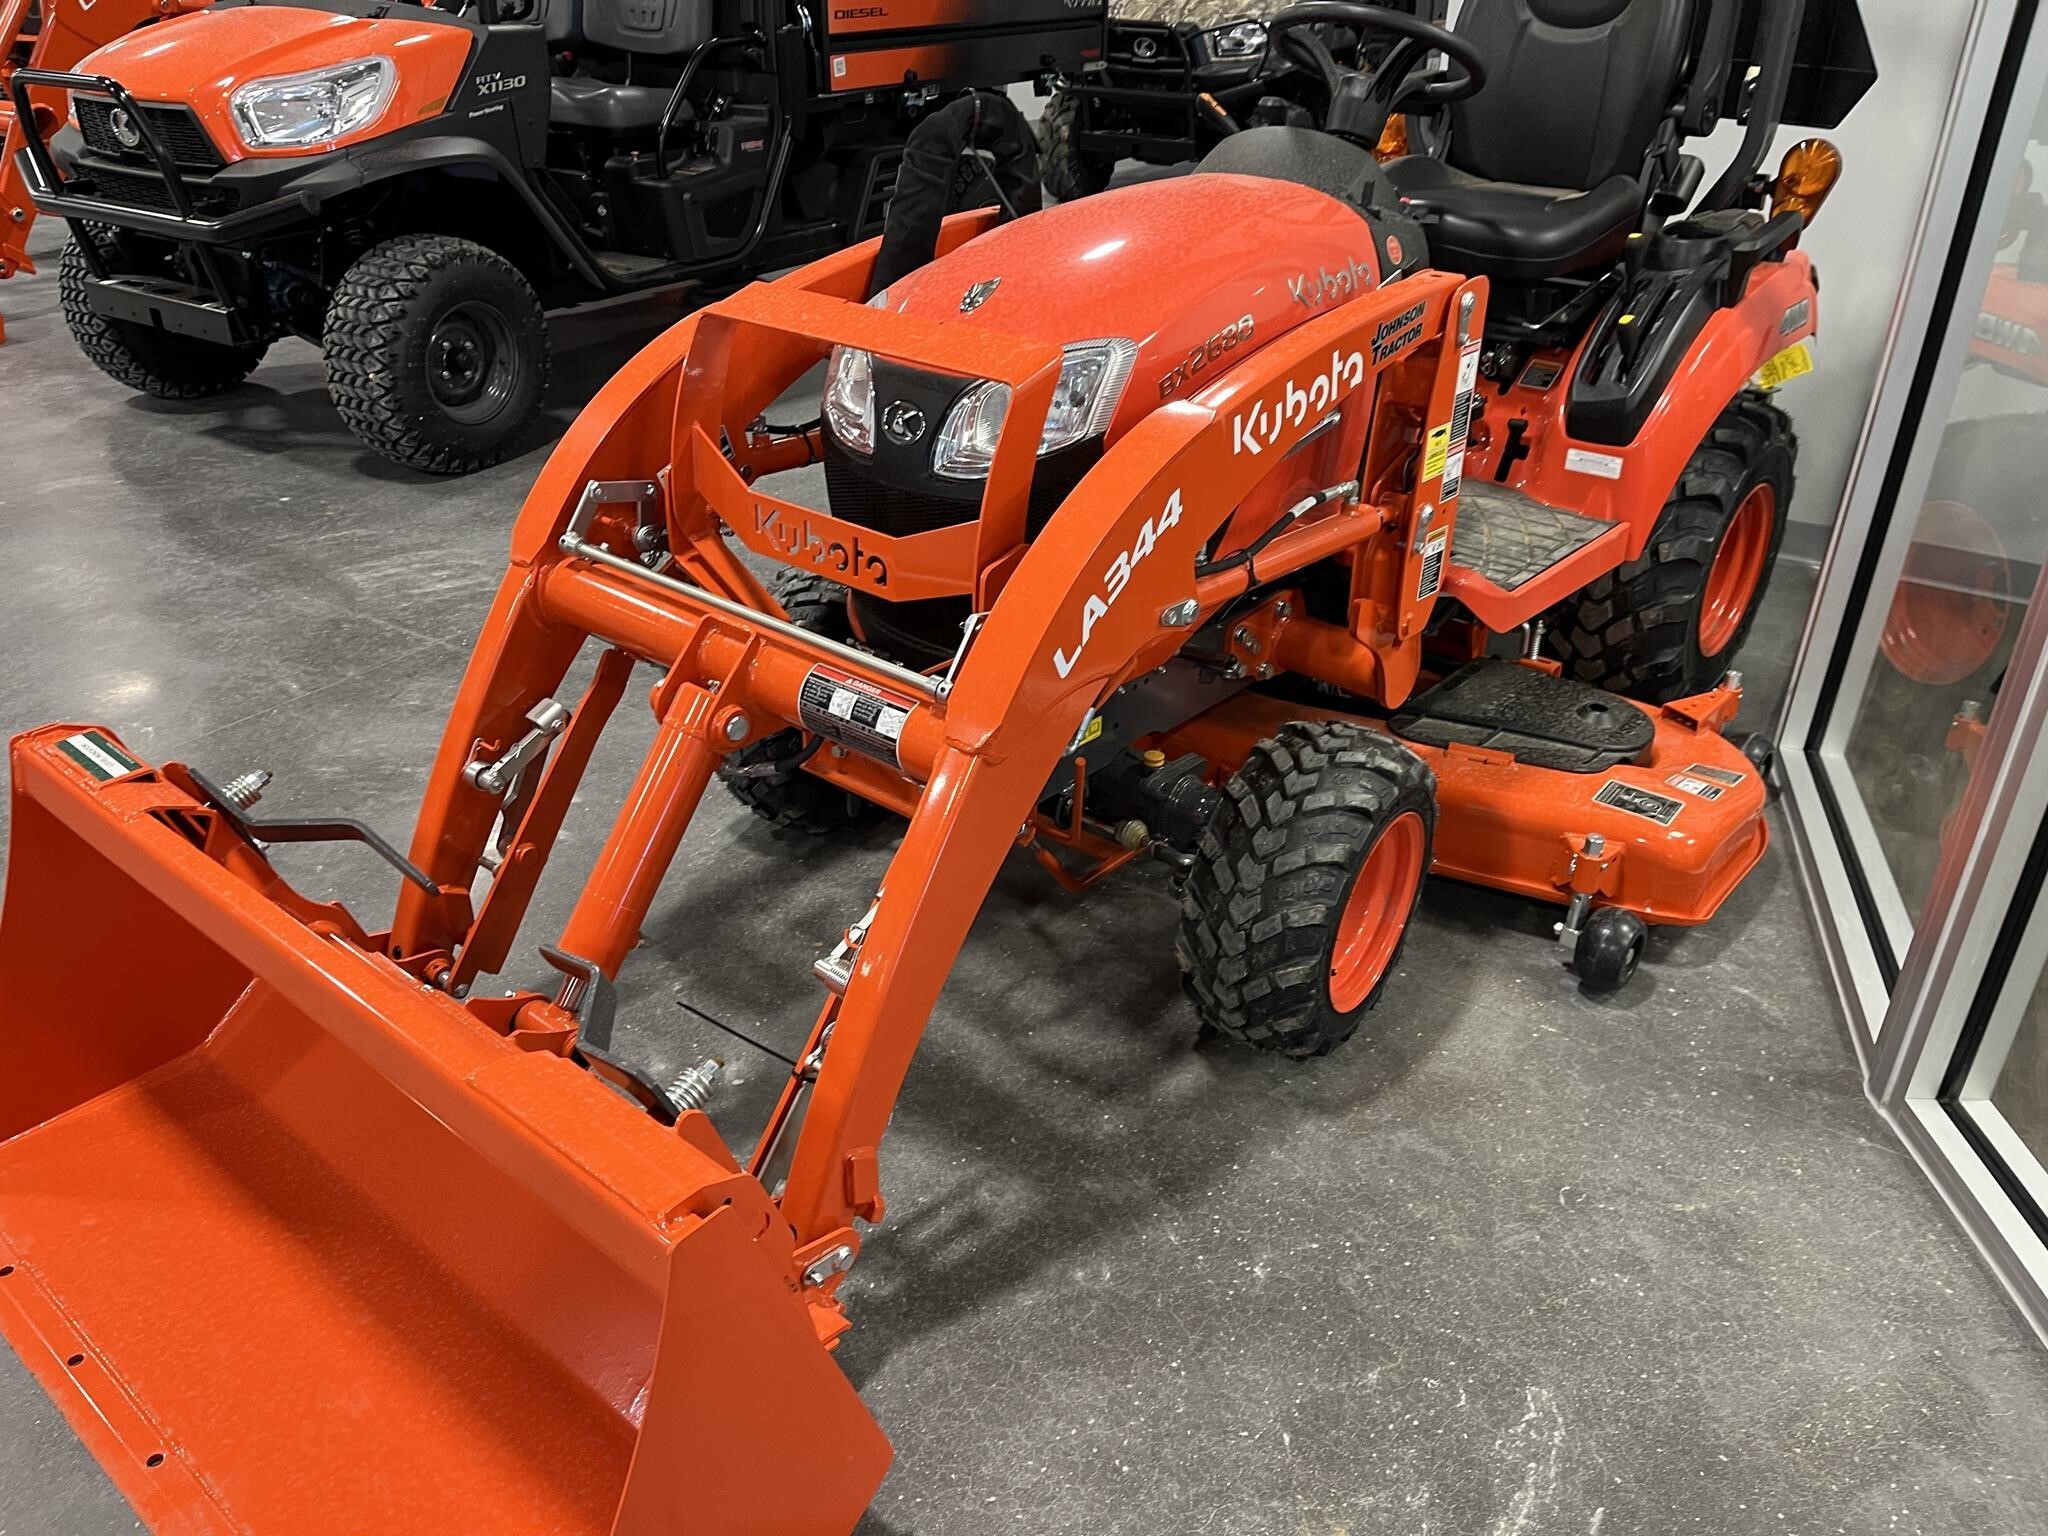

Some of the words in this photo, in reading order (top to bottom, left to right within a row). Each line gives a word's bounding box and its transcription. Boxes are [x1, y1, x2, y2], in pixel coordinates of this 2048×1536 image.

[834, 7, 890, 20] DIESEL
[475, 71, 501, 85] RTV
[477, 75, 526, 97] X1130
[1287, 256, 1372, 309] Kubota
[1158, 313, 1255, 399] BX2680
[1233, 349, 1364, 455] Kubota
[754, 503, 888, 588] Kubota
[1053, 487, 1183, 679] LA344
[851, 680, 882, 695] DANGER
